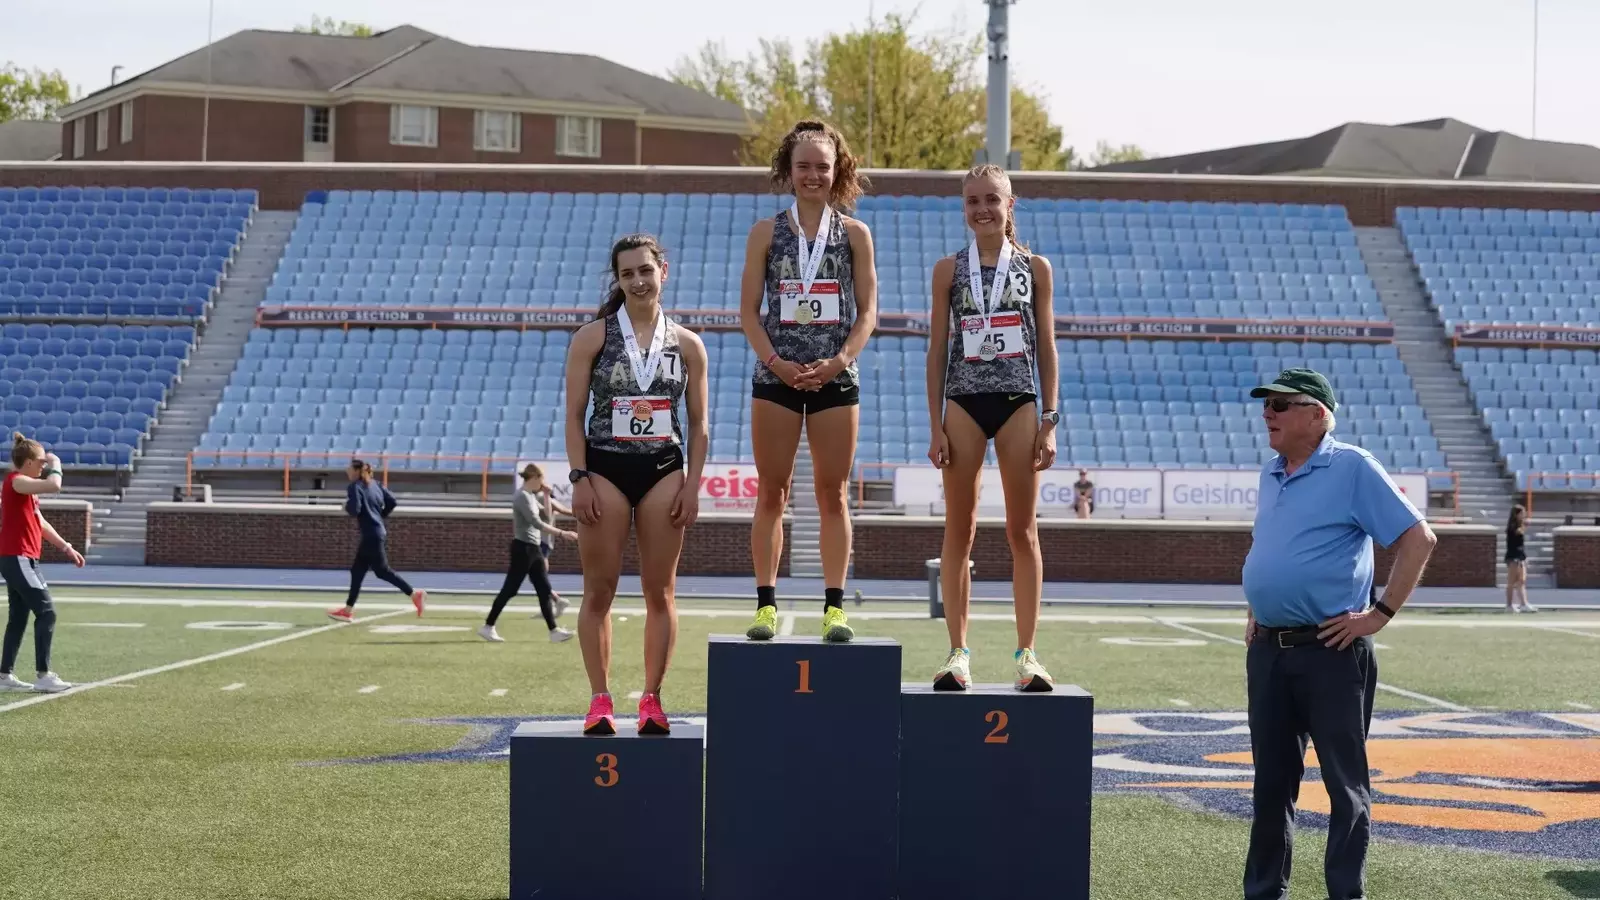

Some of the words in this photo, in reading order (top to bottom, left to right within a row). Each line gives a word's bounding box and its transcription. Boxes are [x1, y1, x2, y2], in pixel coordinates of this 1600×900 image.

[1015, 272, 1029, 297] 3
[288, 310, 348, 321] RESERVED
[355, 310, 410, 321] SECTION
[453, 311, 516, 322] RESERVED
[521, 311, 577, 322] SECTION
[1070, 322, 1133, 333] RESERVED
[1138, 322, 1194, 333] SECTION
[1235, 324, 1298, 335] RESERVED
[1304, 325, 1358, 337] SECTION
[1487, 329, 1548, 341] RESERVED
[663, 353, 677, 376] 7
[629, 415, 654, 436] 62
[1041, 482, 1152, 510] Geinger
[1172, 483, 1258, 511] Geising
[794, 659, 814, 694] 1
[983, 709, 1010, 744] 2
[594, 752, 619, 787] 3
